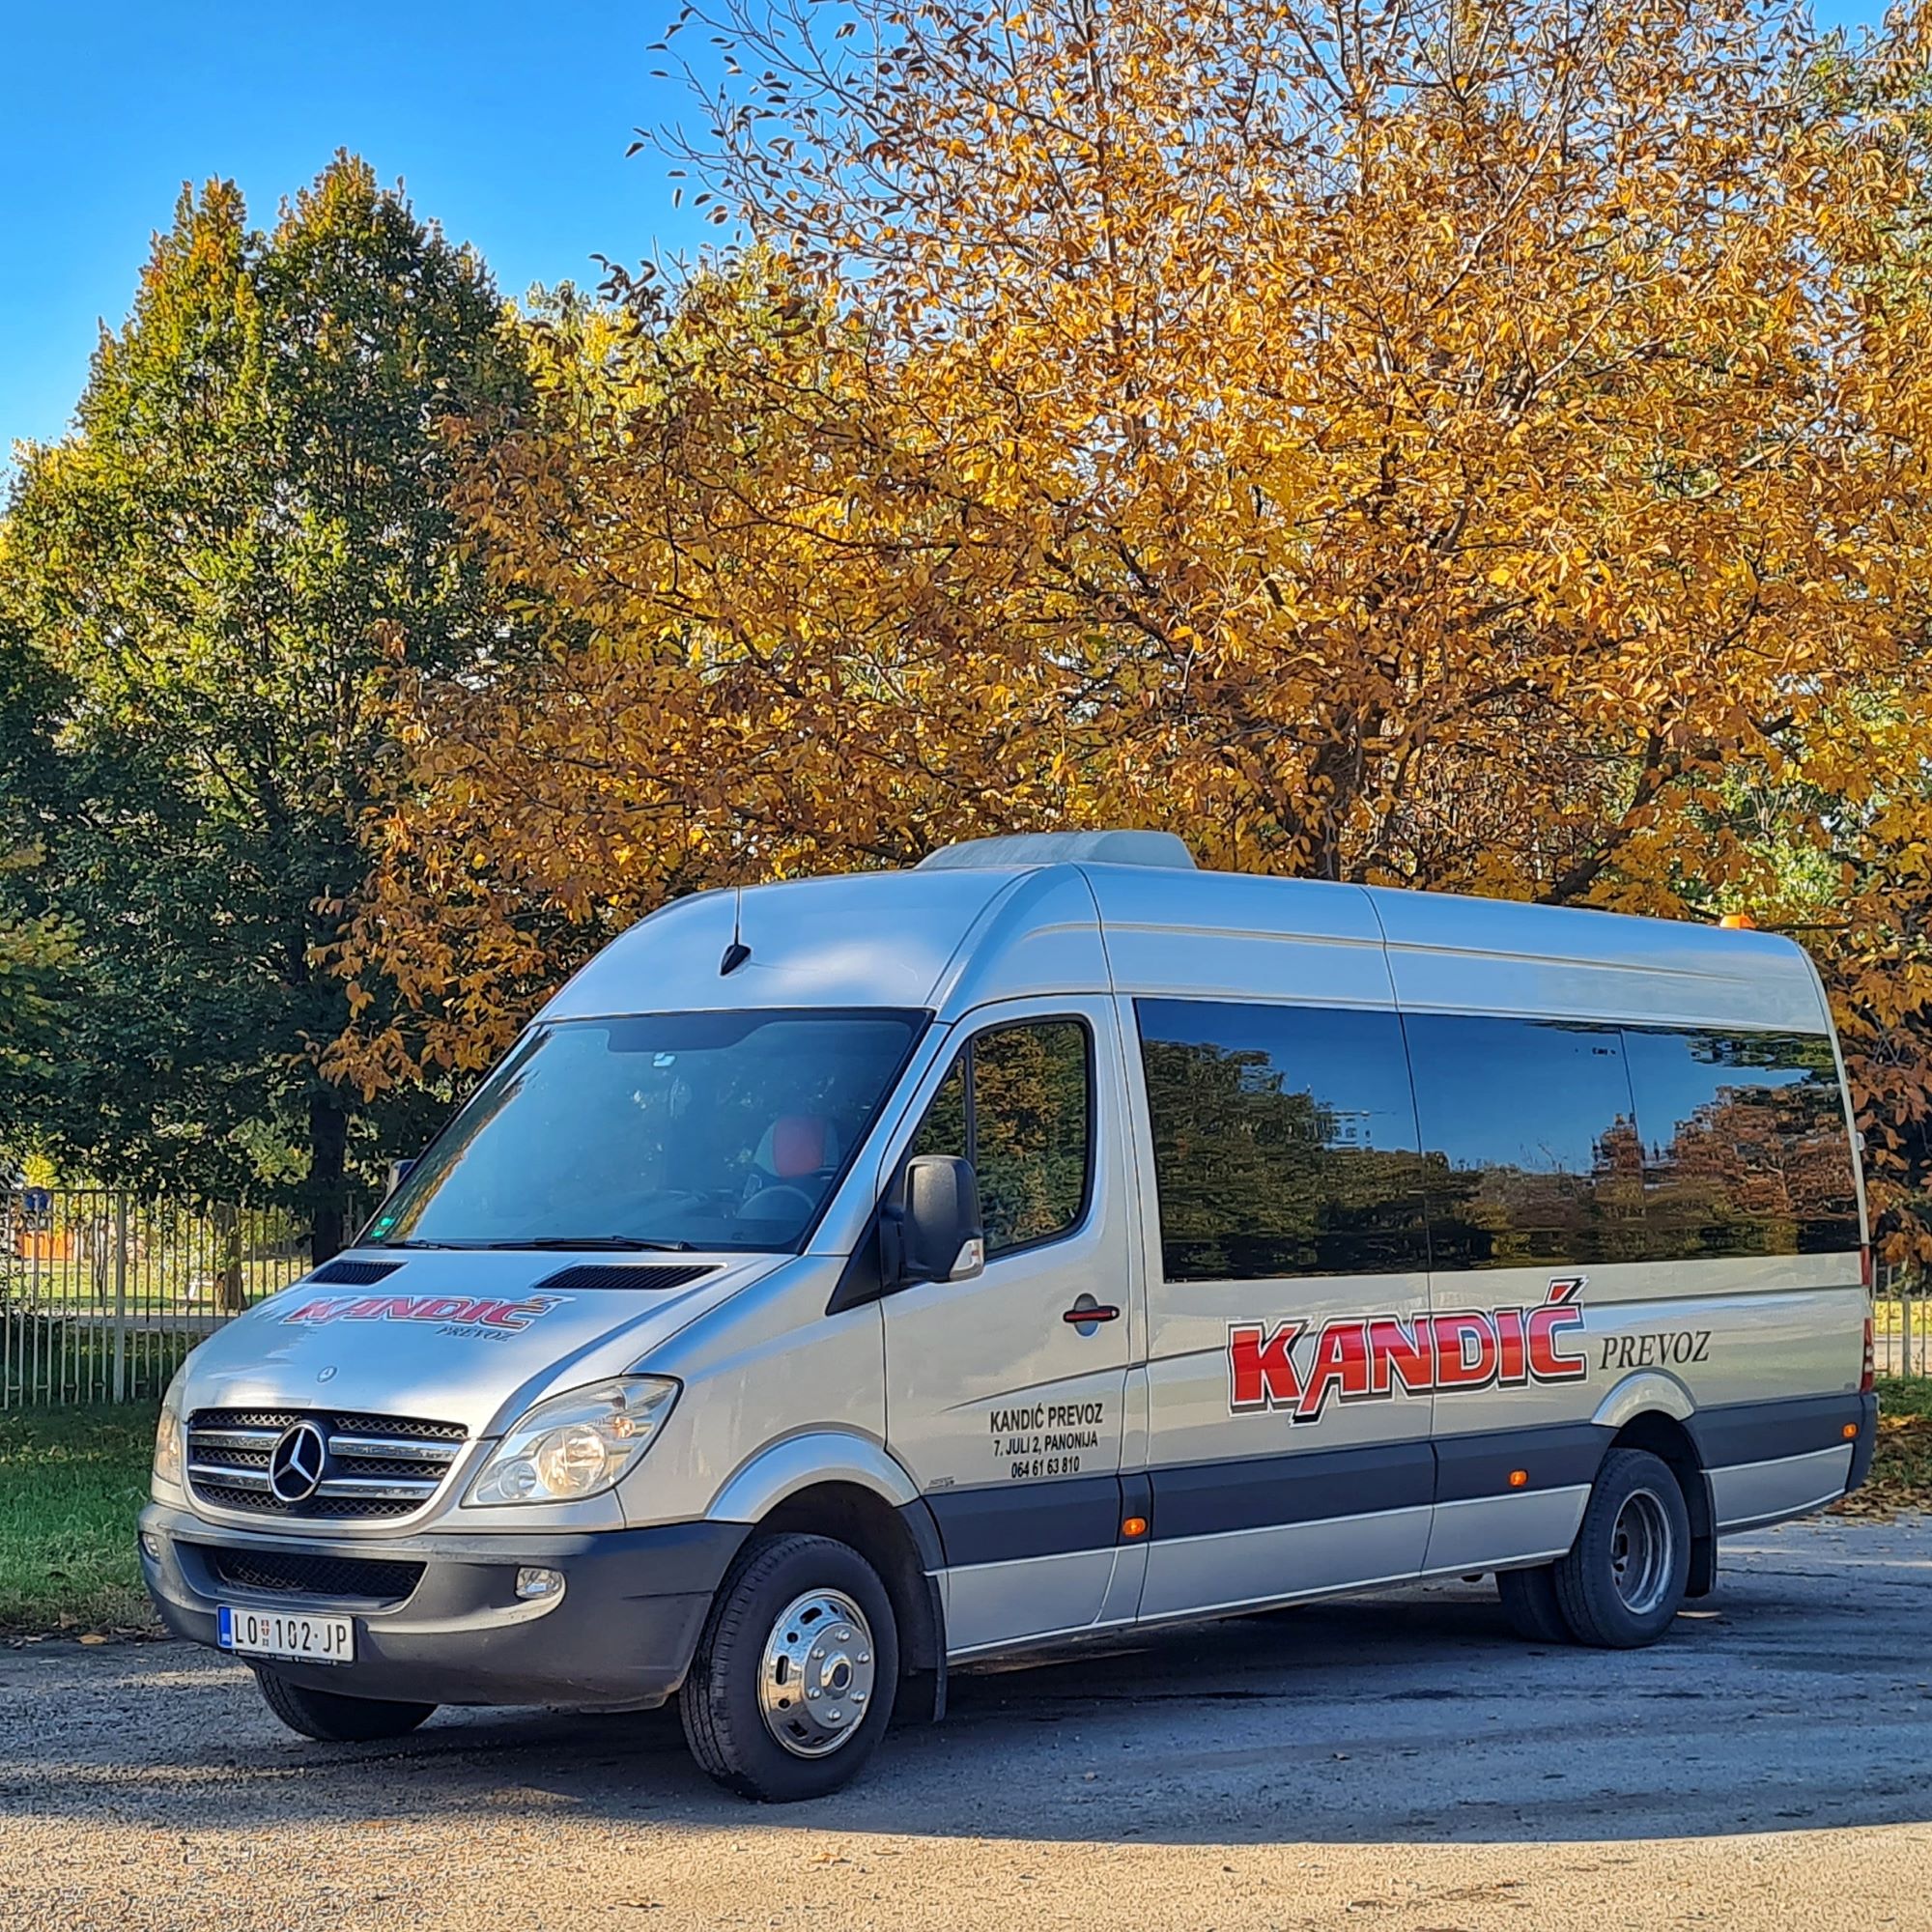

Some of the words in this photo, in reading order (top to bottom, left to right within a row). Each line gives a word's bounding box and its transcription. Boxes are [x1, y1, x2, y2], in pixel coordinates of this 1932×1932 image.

[280, 1295, 564, 1330] KANDIĆ
[1227, 1276, 1587, 1426] KANDIĆ
[1599, 1330, 1711, 1370] PREVOZ
[991, 1403, 1044, 1433] KANDIĆ
[1048, 1404, 1103, 1428] PREVOZ
[994, 1440, 1003, 1456] 7.
[1006, 1436, 1030, 1455] JULI
[1033, 1436, 1041, 1455] 2,
[1044, 1431, 1097, 1451] PANONIJA
[1011, 1461, 1029, 1478] 064
[1033, 1459, 1043, 1476] 61
[1047, 1458, 1059, 1474] 63
[1062, 1456, 1080, 1473] 810
[235, 1614, 257, 1644] LO
